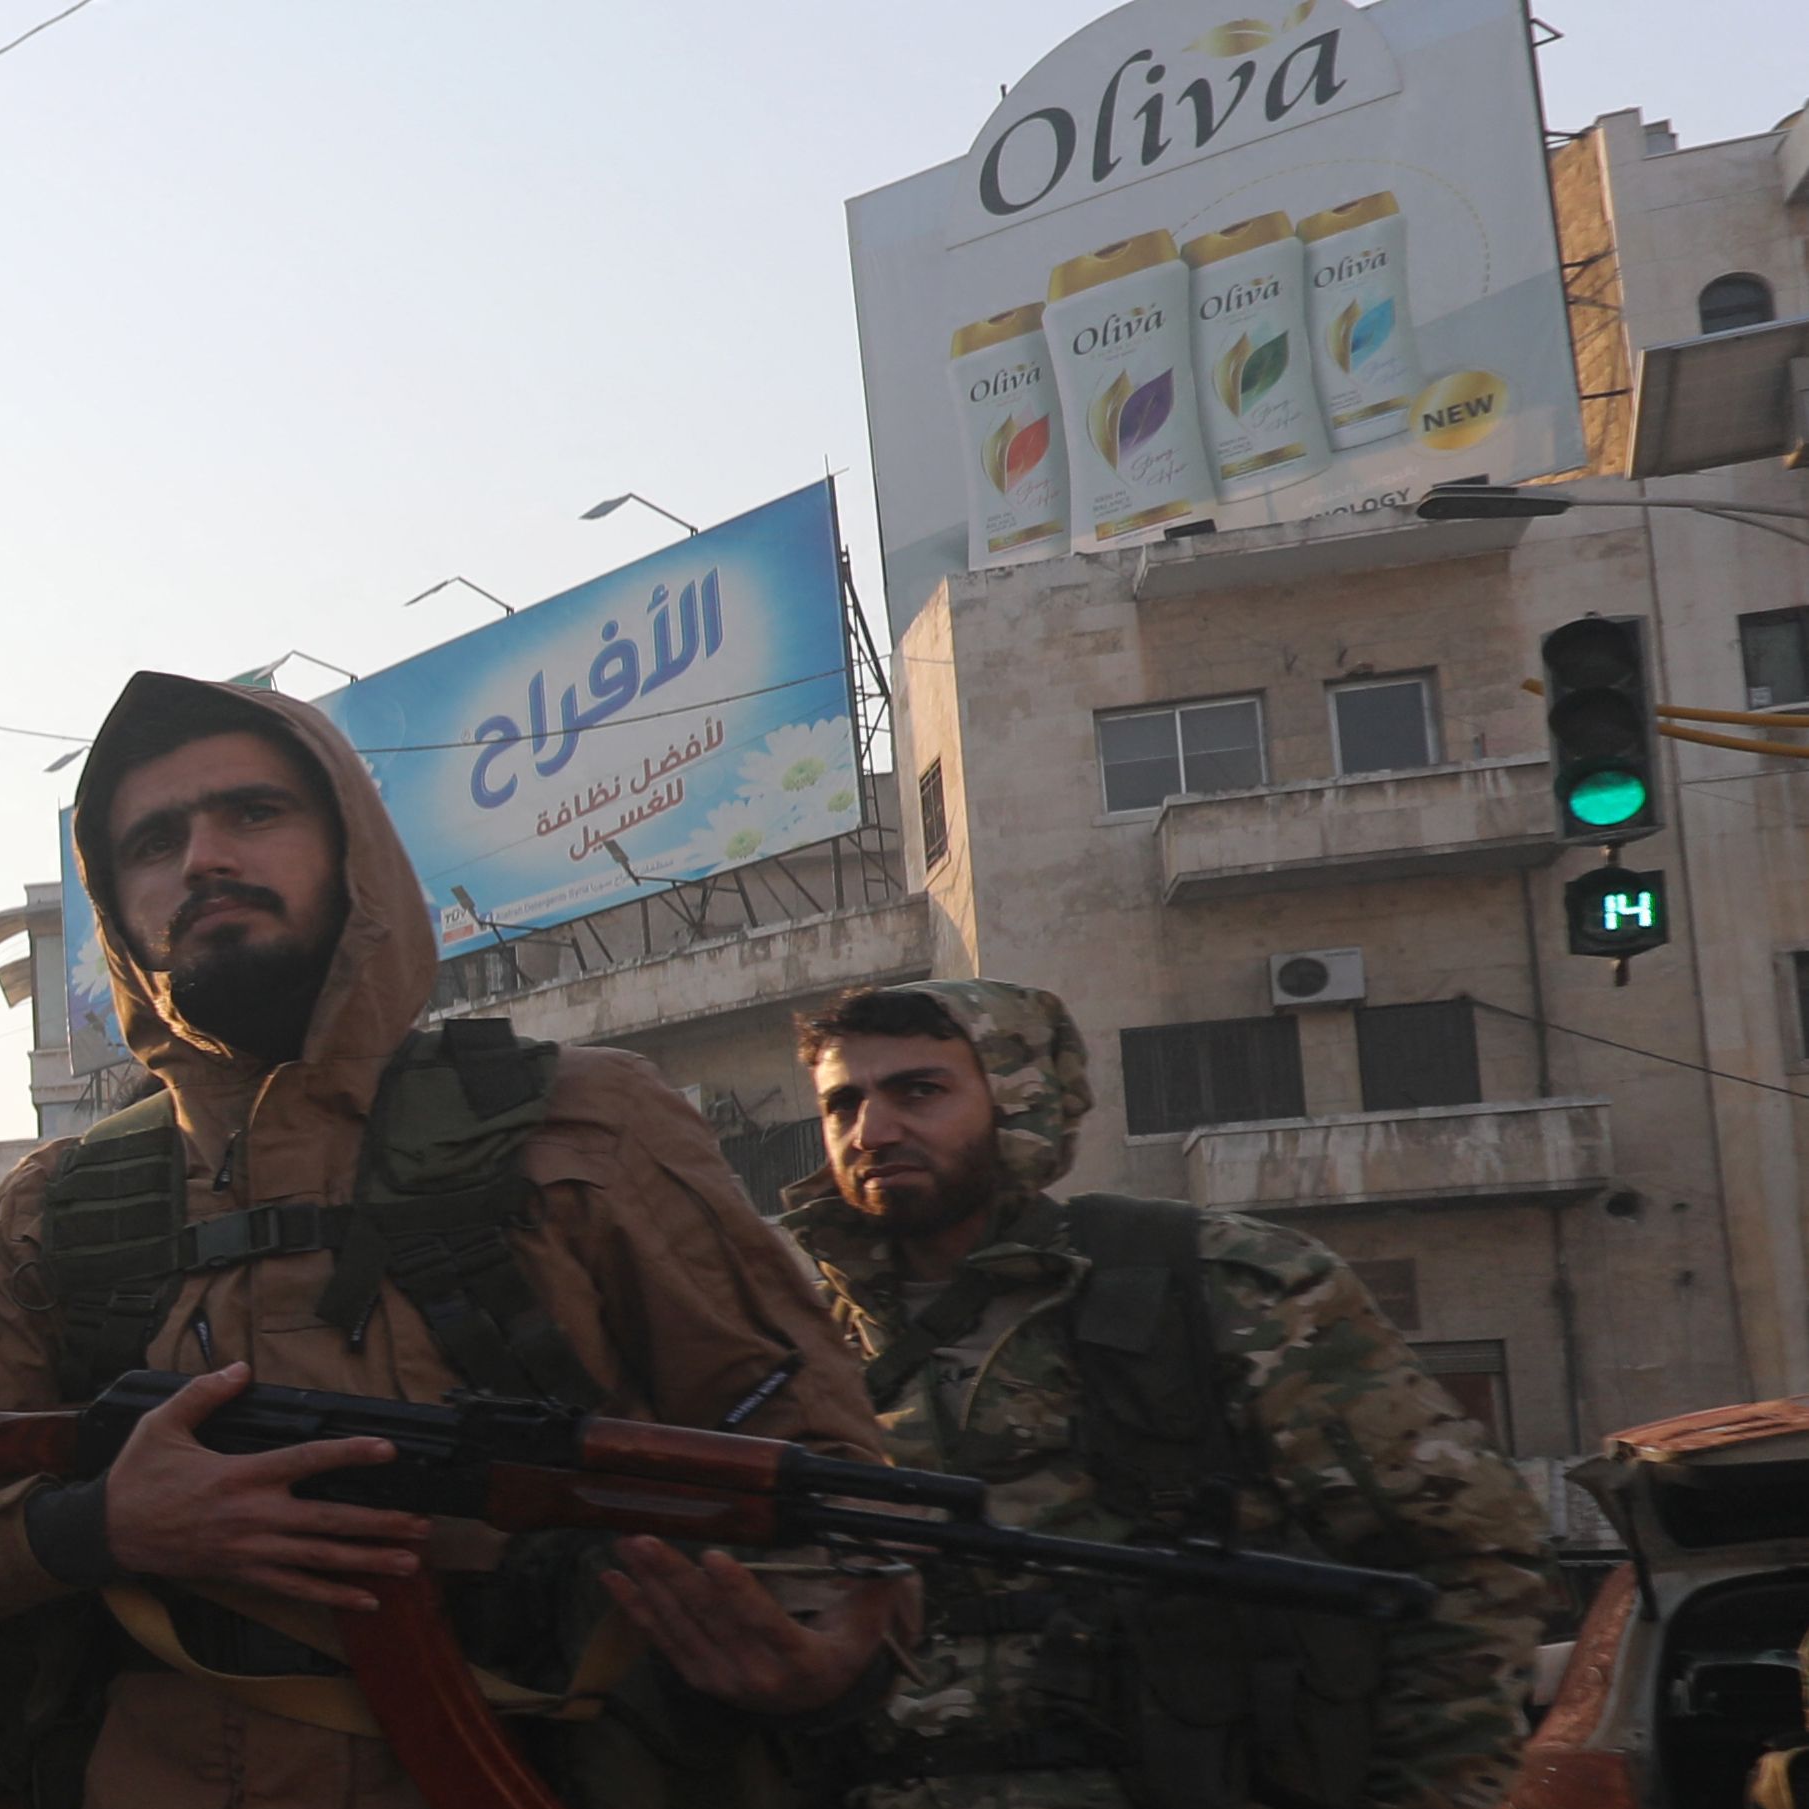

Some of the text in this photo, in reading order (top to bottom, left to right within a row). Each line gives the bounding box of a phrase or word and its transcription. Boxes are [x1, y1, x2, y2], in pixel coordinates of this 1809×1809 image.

[979, 28, 1348, 217] Oliva
[1313, 251, 1389, 289] Oliva
[1199, 279, 1281, 321] Oliva
[1072, 309, 1165, 356] Oliva
[970, 365, 1042, 402] Oliva
[1423, 393, 1494, 432] NEW
[471, 566, 724, 809] الأفراح
[536, 716, 724, 836] لأفضل نظافة
